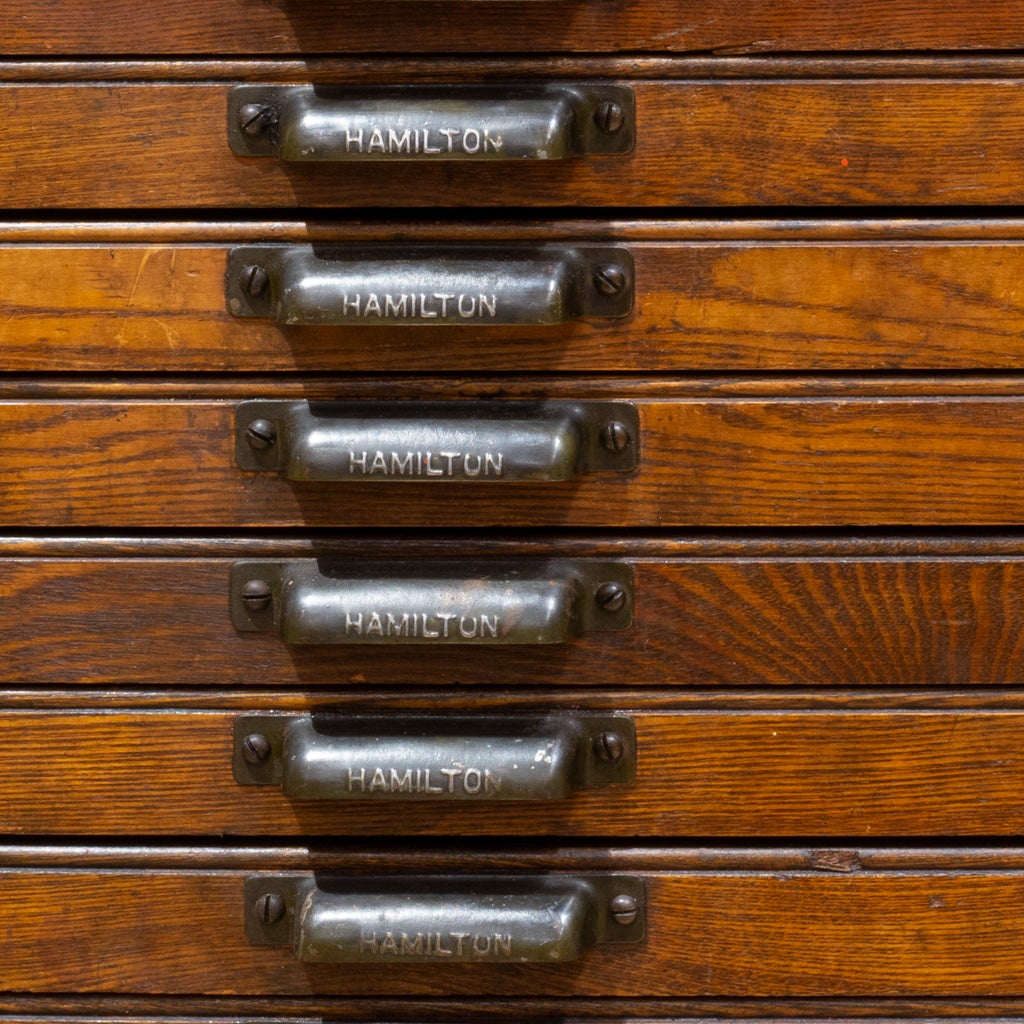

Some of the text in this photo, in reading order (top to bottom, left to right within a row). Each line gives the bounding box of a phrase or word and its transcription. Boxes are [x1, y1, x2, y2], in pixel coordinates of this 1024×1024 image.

[345, 129, 502, 154] HAMILTON
[343, 294, 497, 318] HAMILTON
[349, 451, 504, 476] HAMILTON
[346, 613, 499, 638] HAMILTON
[348, 768, 500, 794] HAMILTON
[360, 932, 512, 956] HAMILTON
